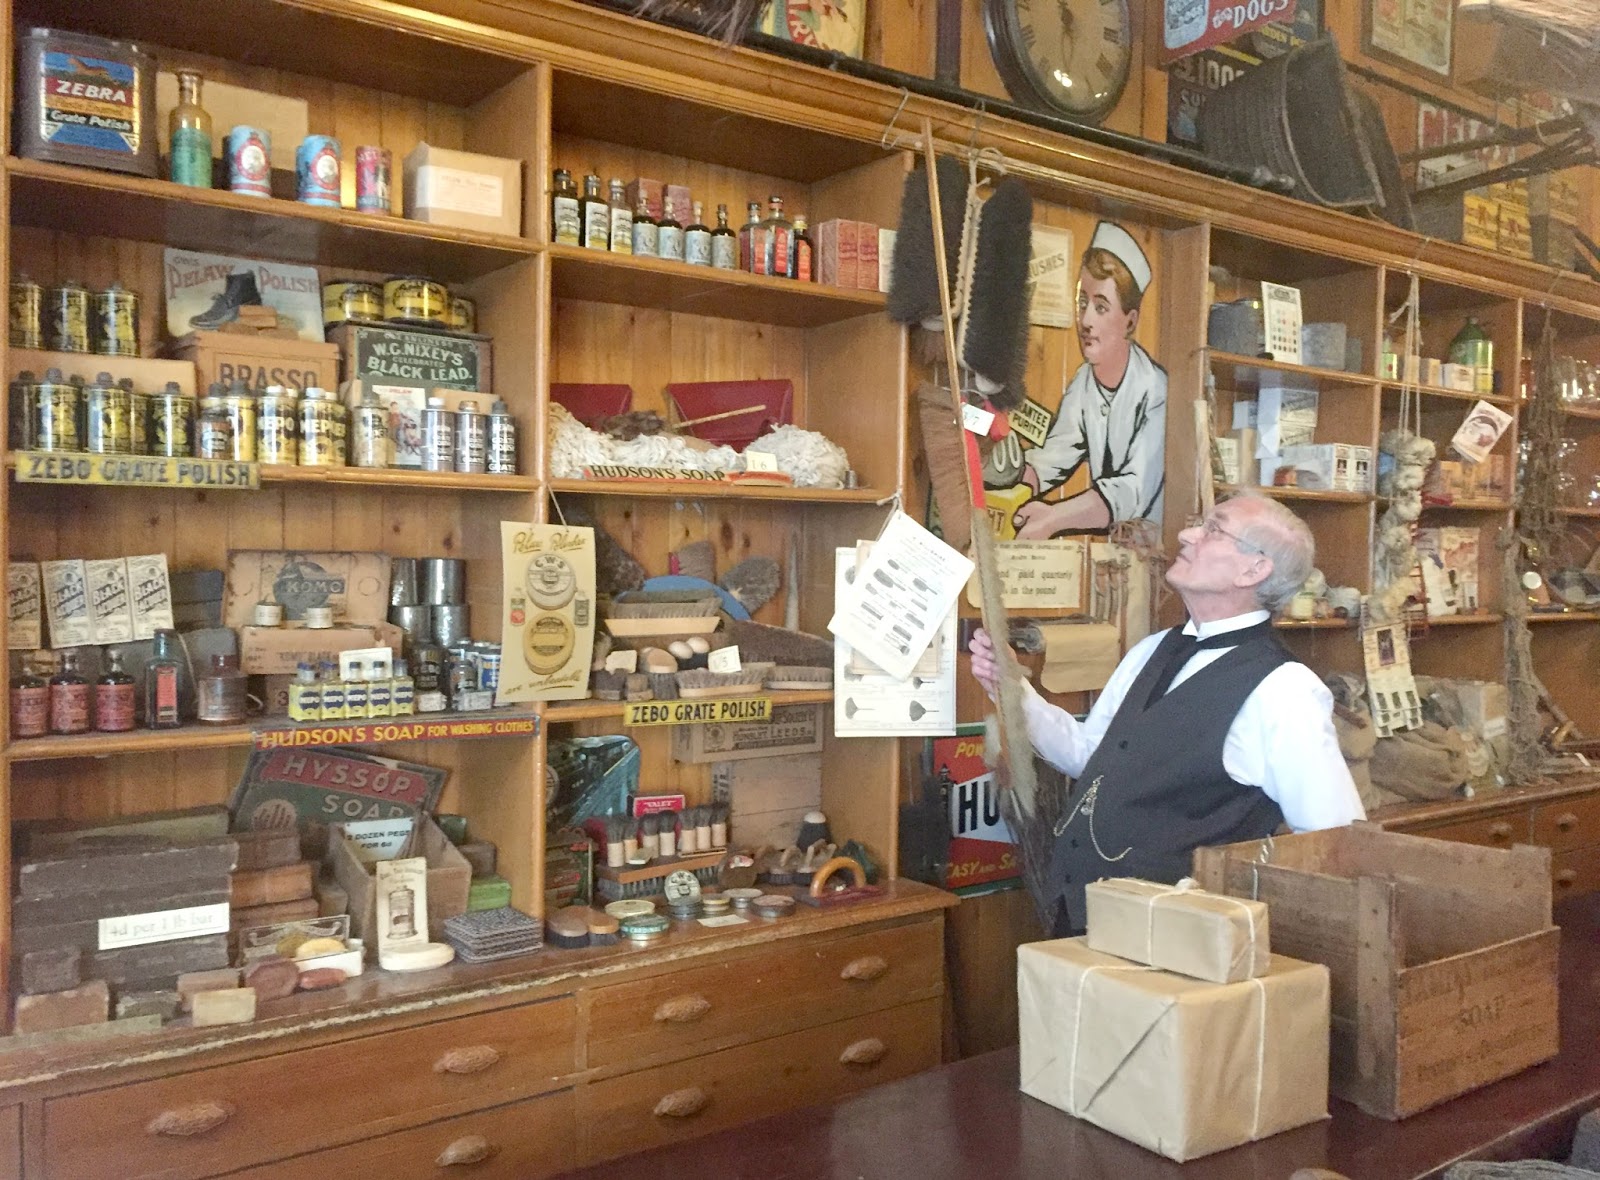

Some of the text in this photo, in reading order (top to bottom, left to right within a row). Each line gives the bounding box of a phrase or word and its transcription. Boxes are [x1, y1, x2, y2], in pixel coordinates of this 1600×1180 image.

[56, 80, 126, 103] ZEBRA
[220, 363, 318, 392] BRASSO
[367, 356, 423, 379] BLACK
[1012, 413, 1044, 439] PURITY
[1022, 401, 1048, 427] ANTEE
[28, 456, 250, 486] ZEBO GRATE POLISH
[590, 465, 726, 482] HUDSON'S SOAP
[632, 705, 669, 723] ZEBO
[675, 703, 716, 721] GRATE
[721, 700, 766, 719] POLISH
[261, 721, 534, 748] HUDSON'S SOAP FOR WASHING CLOTHES
[282, 755, 411, 794] HYSSOP
[958, 780, 999, 834] HU
[355, 831, 385, 840] DOZEN
